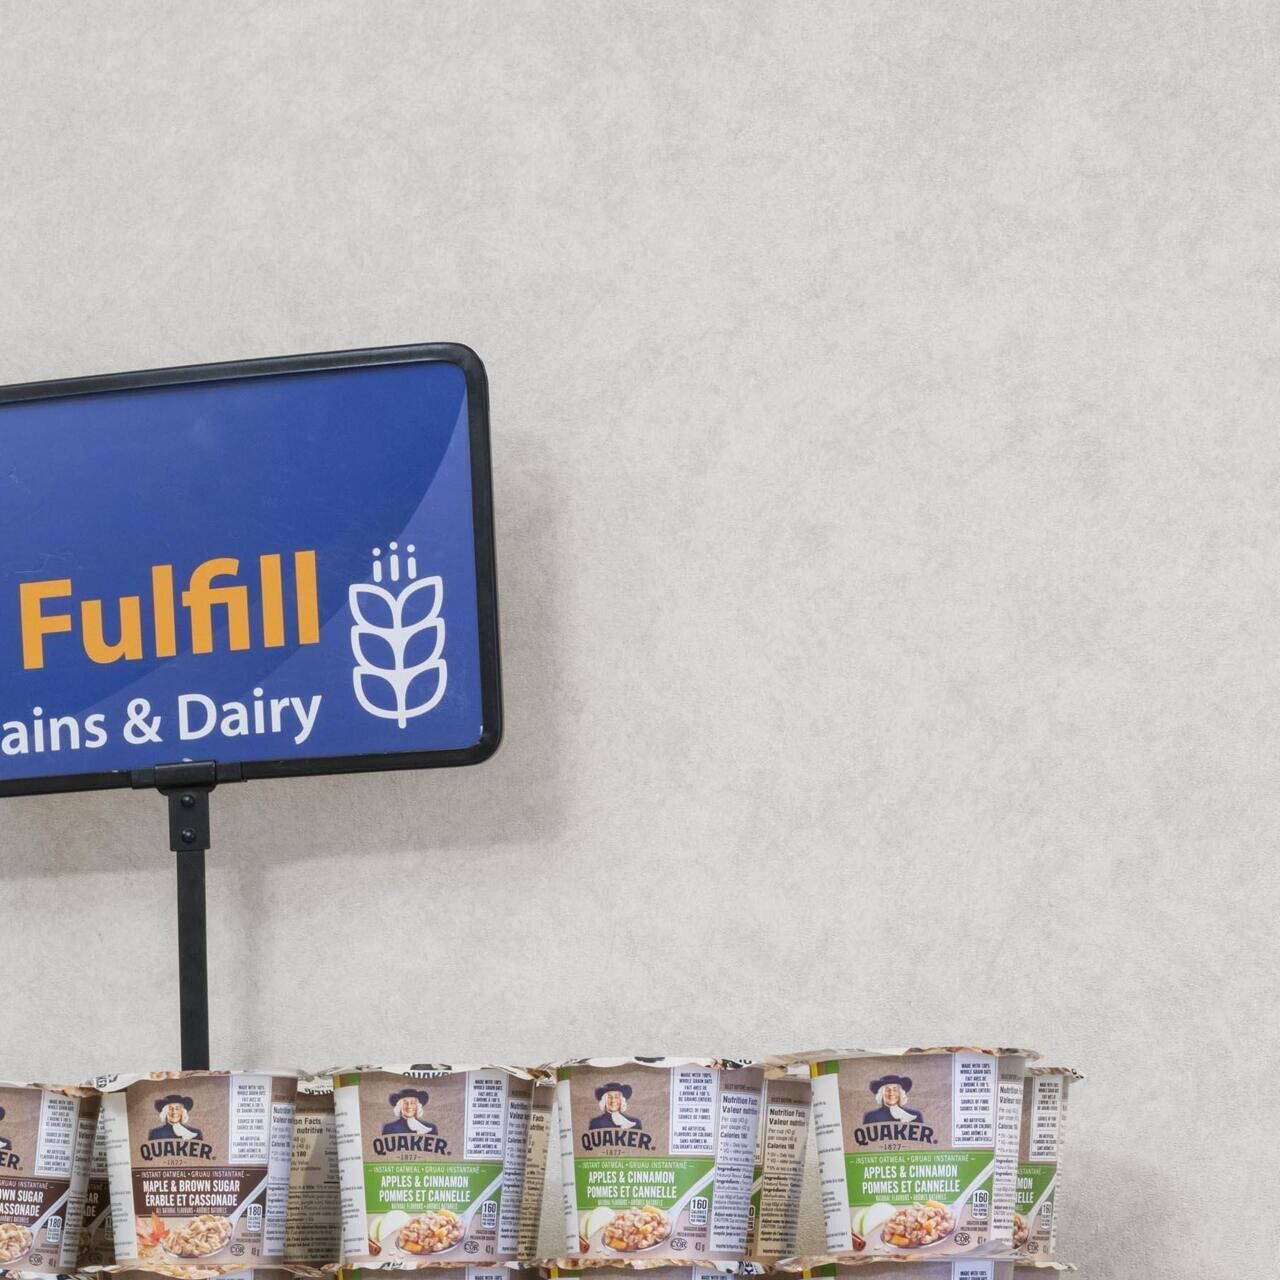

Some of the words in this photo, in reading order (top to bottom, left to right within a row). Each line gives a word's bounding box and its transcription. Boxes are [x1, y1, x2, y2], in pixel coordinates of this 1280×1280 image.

[19, 550, 320, 670] Fulfill
[123, 698, 163, 745] &
[177, 687, 323, 745] Dairy
[722, 1105, 741, 1114] Valeur
[770, 1108, 795, 1117] Nutrition
[769, 1118, 789, 1126] Valeur
[581, 1130, 652, 1151] QUAKER
[854, 1124, 934, 1146] QUAKER
[141, 1142, 212, 1161] QUAKER
[373, 1135, 448, 1156] QUAKER
[856, 1156, 878, 1164] INSTANT
[879, 1155, 905, 1163] OATMEAL
[934, 1154, 969, 1162] INSTANTANÉ
[589, 1171, 616, 1183] APPLES
[619, 1172, 625, 1183] &
[627, 1171, 675, 1183] CINNAMON
[864, 1166, 897, 1179] APPLES
[900, 1167, 906, 1177] &
[909, 1165, 957, 1177] CINNAMON
[18, 1181, 48, 1189] INSTANTANÉ
[143, 1181, 168, 1193] MAPLE
[171, 1181, 177, 1191] &
[179, 1180, 209, 1192] BROWN
[213, 1180, 240, 1192] SUGAR
[381, 1176, 412, 1188] APPLES
[415, 1176, 421, 1187] &
[423, 1176, 468, 1188] CINNAMON
[862, 1181, 899, 1194] POMMES
[902, 1181, 911, 1193] ET
[915, 1180, 960, 1193] CANNELLE
[18, 1190, 43, 1203] SUGAR
[379, 1190, 414, 1201] POMMES
[416, 1190, 426, 1201] ET
[428, 1190, 470, 1202] CANNELLE
[587, 1186, 618, 1198] POMMES
[620, 1186, 630, 1198] ET
[633, 1186, 677, 1198] CANNELLE
[974, 1192, 988, 1203] 160
[146, 1192, 174, 1206] ÉRABLE
[176, 1194, 186, 1206] ET
[189, 1194, 237, 1206] CASSONADE
[692, 1199, 707, 1209] 160
[249, 1206, 261, 1216] 180
[484, 1203, 496, 1212] 160
[50, 1219, 61, 1227] 180
